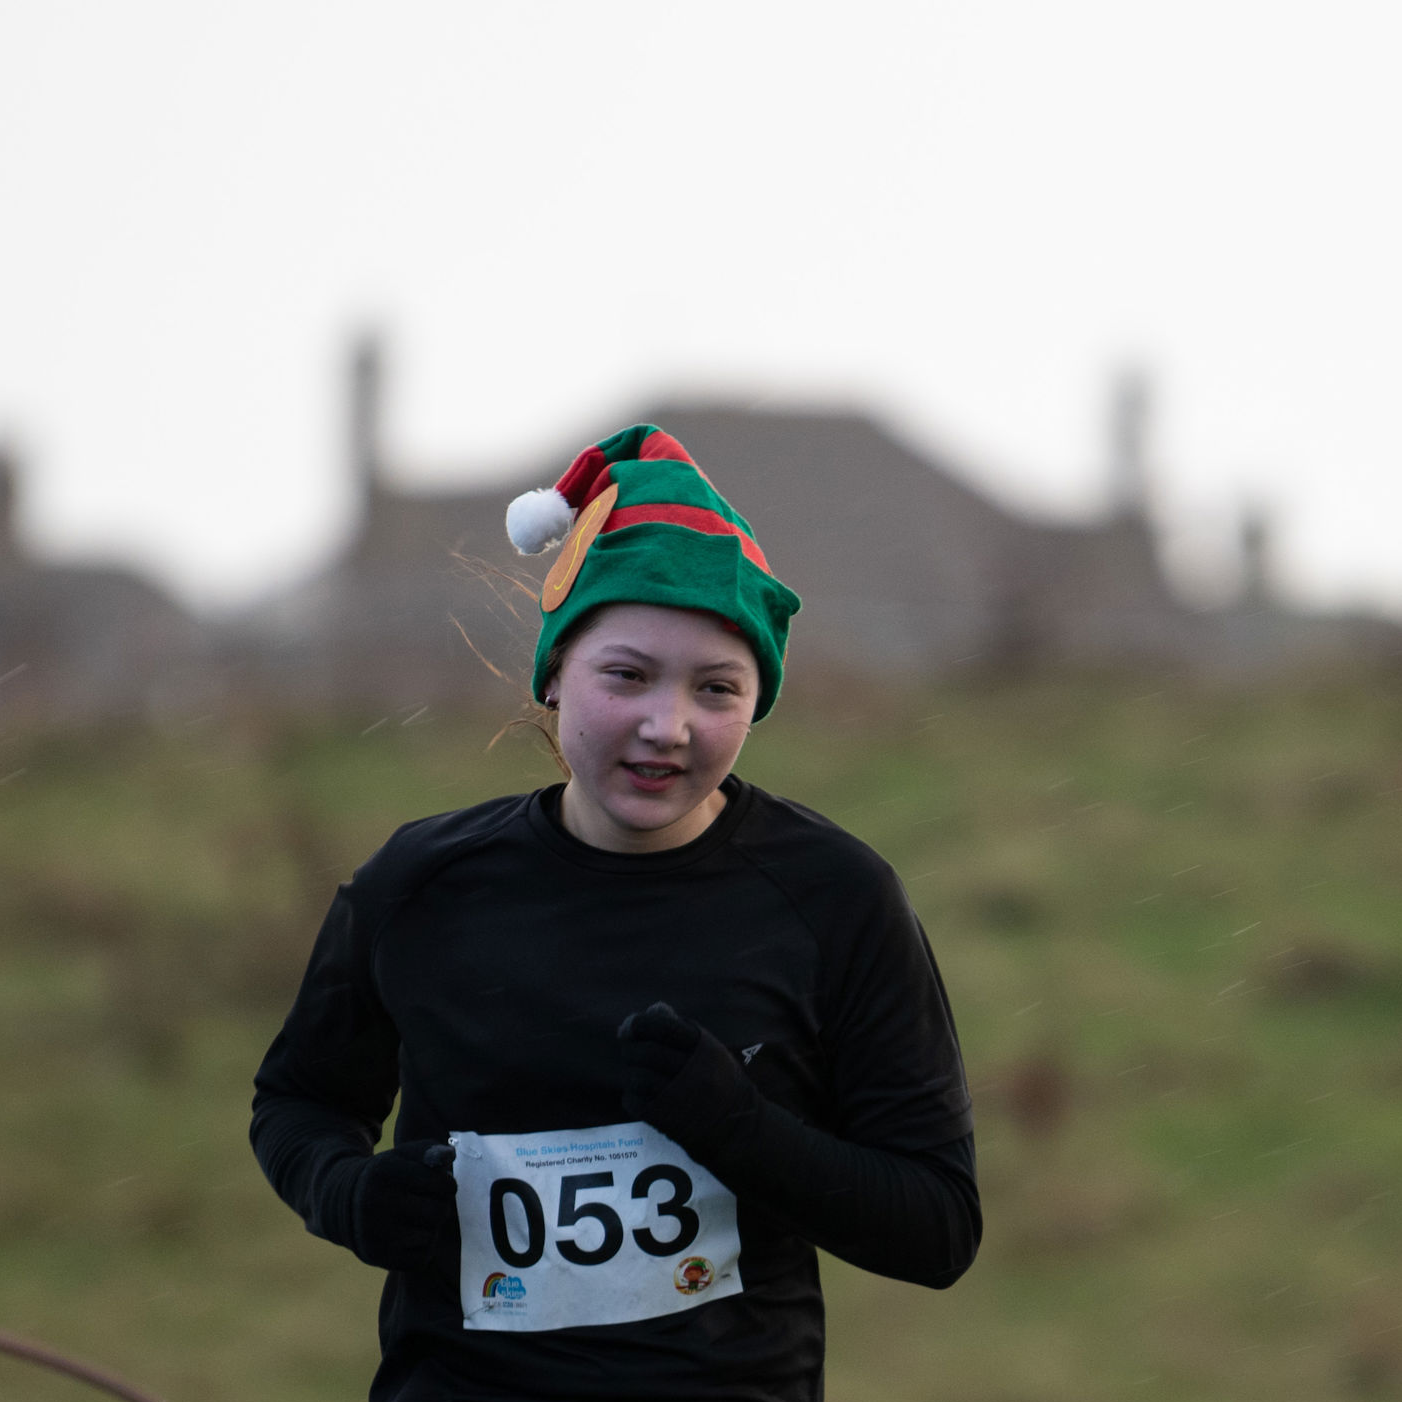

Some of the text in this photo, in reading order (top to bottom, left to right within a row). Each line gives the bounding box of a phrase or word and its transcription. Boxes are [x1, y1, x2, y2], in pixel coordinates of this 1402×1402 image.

[515, 1137, 644, 1157] Blue Skies Hospitals Fund
[525, 1157, 565, 1168] Registered
[566, 1154, 593, 1165] Charity
[594, 1153, 607, 1161] No.
[489, 1164, 700, 1269] 053
